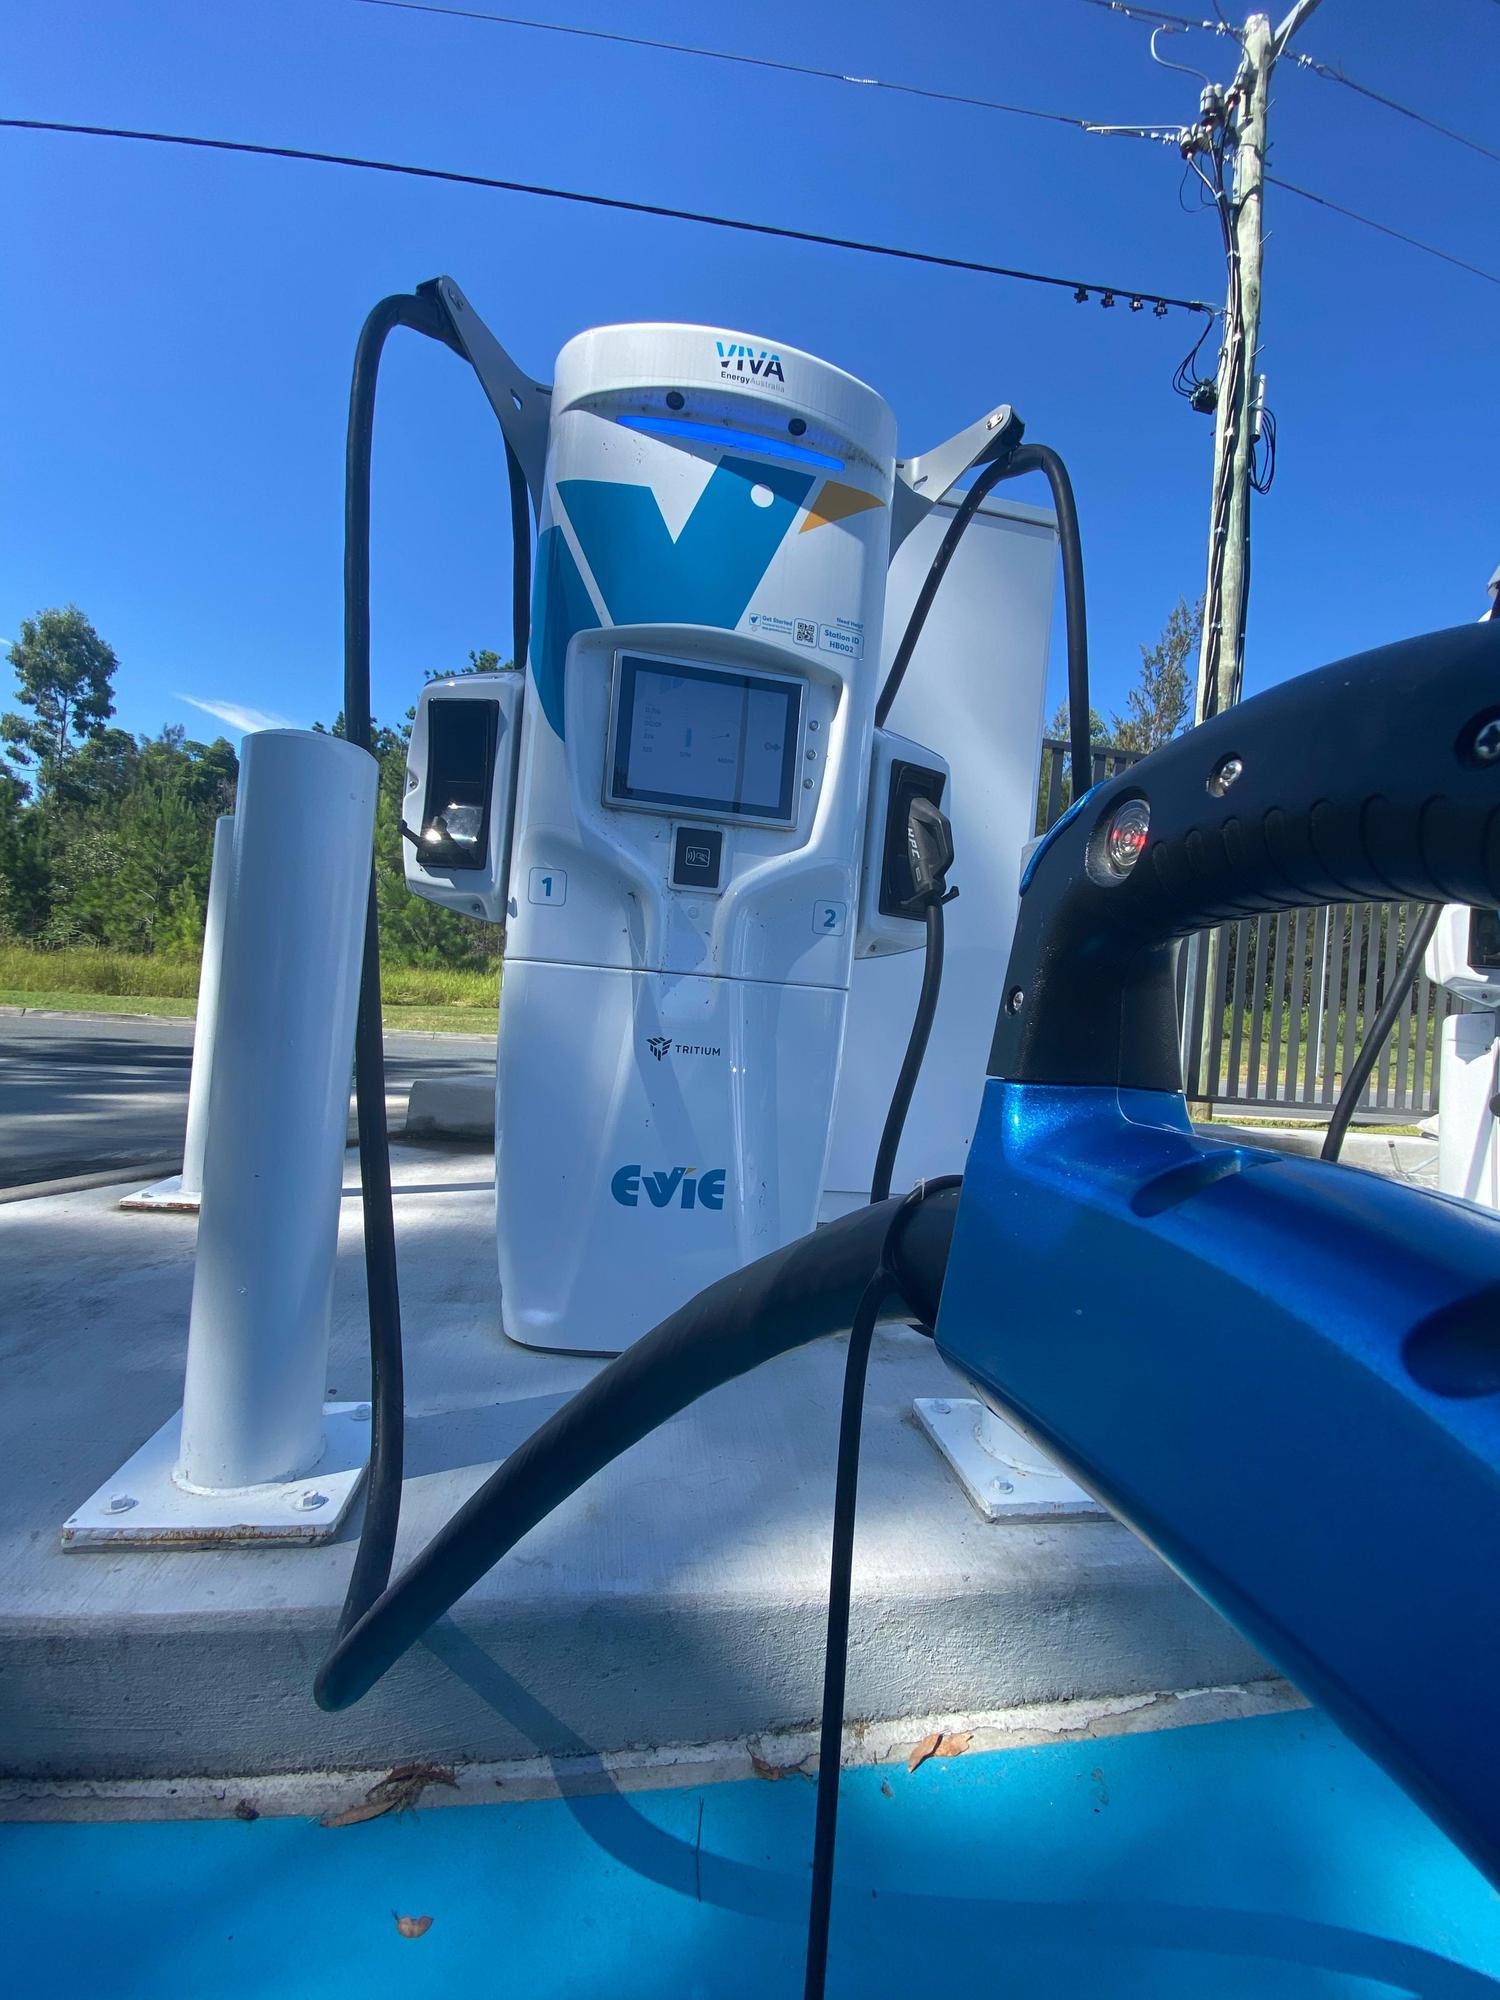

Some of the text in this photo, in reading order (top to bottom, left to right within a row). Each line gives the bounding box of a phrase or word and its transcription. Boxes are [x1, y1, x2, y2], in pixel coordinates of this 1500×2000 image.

[716, 341, 784, 383] VIVA
[824, 629, 860, 645] Station ID
[541, 877, 553, 897] 1
[823, 908, 837, 928] 2
[675, 1044, 721, 1057] TRITIUM
